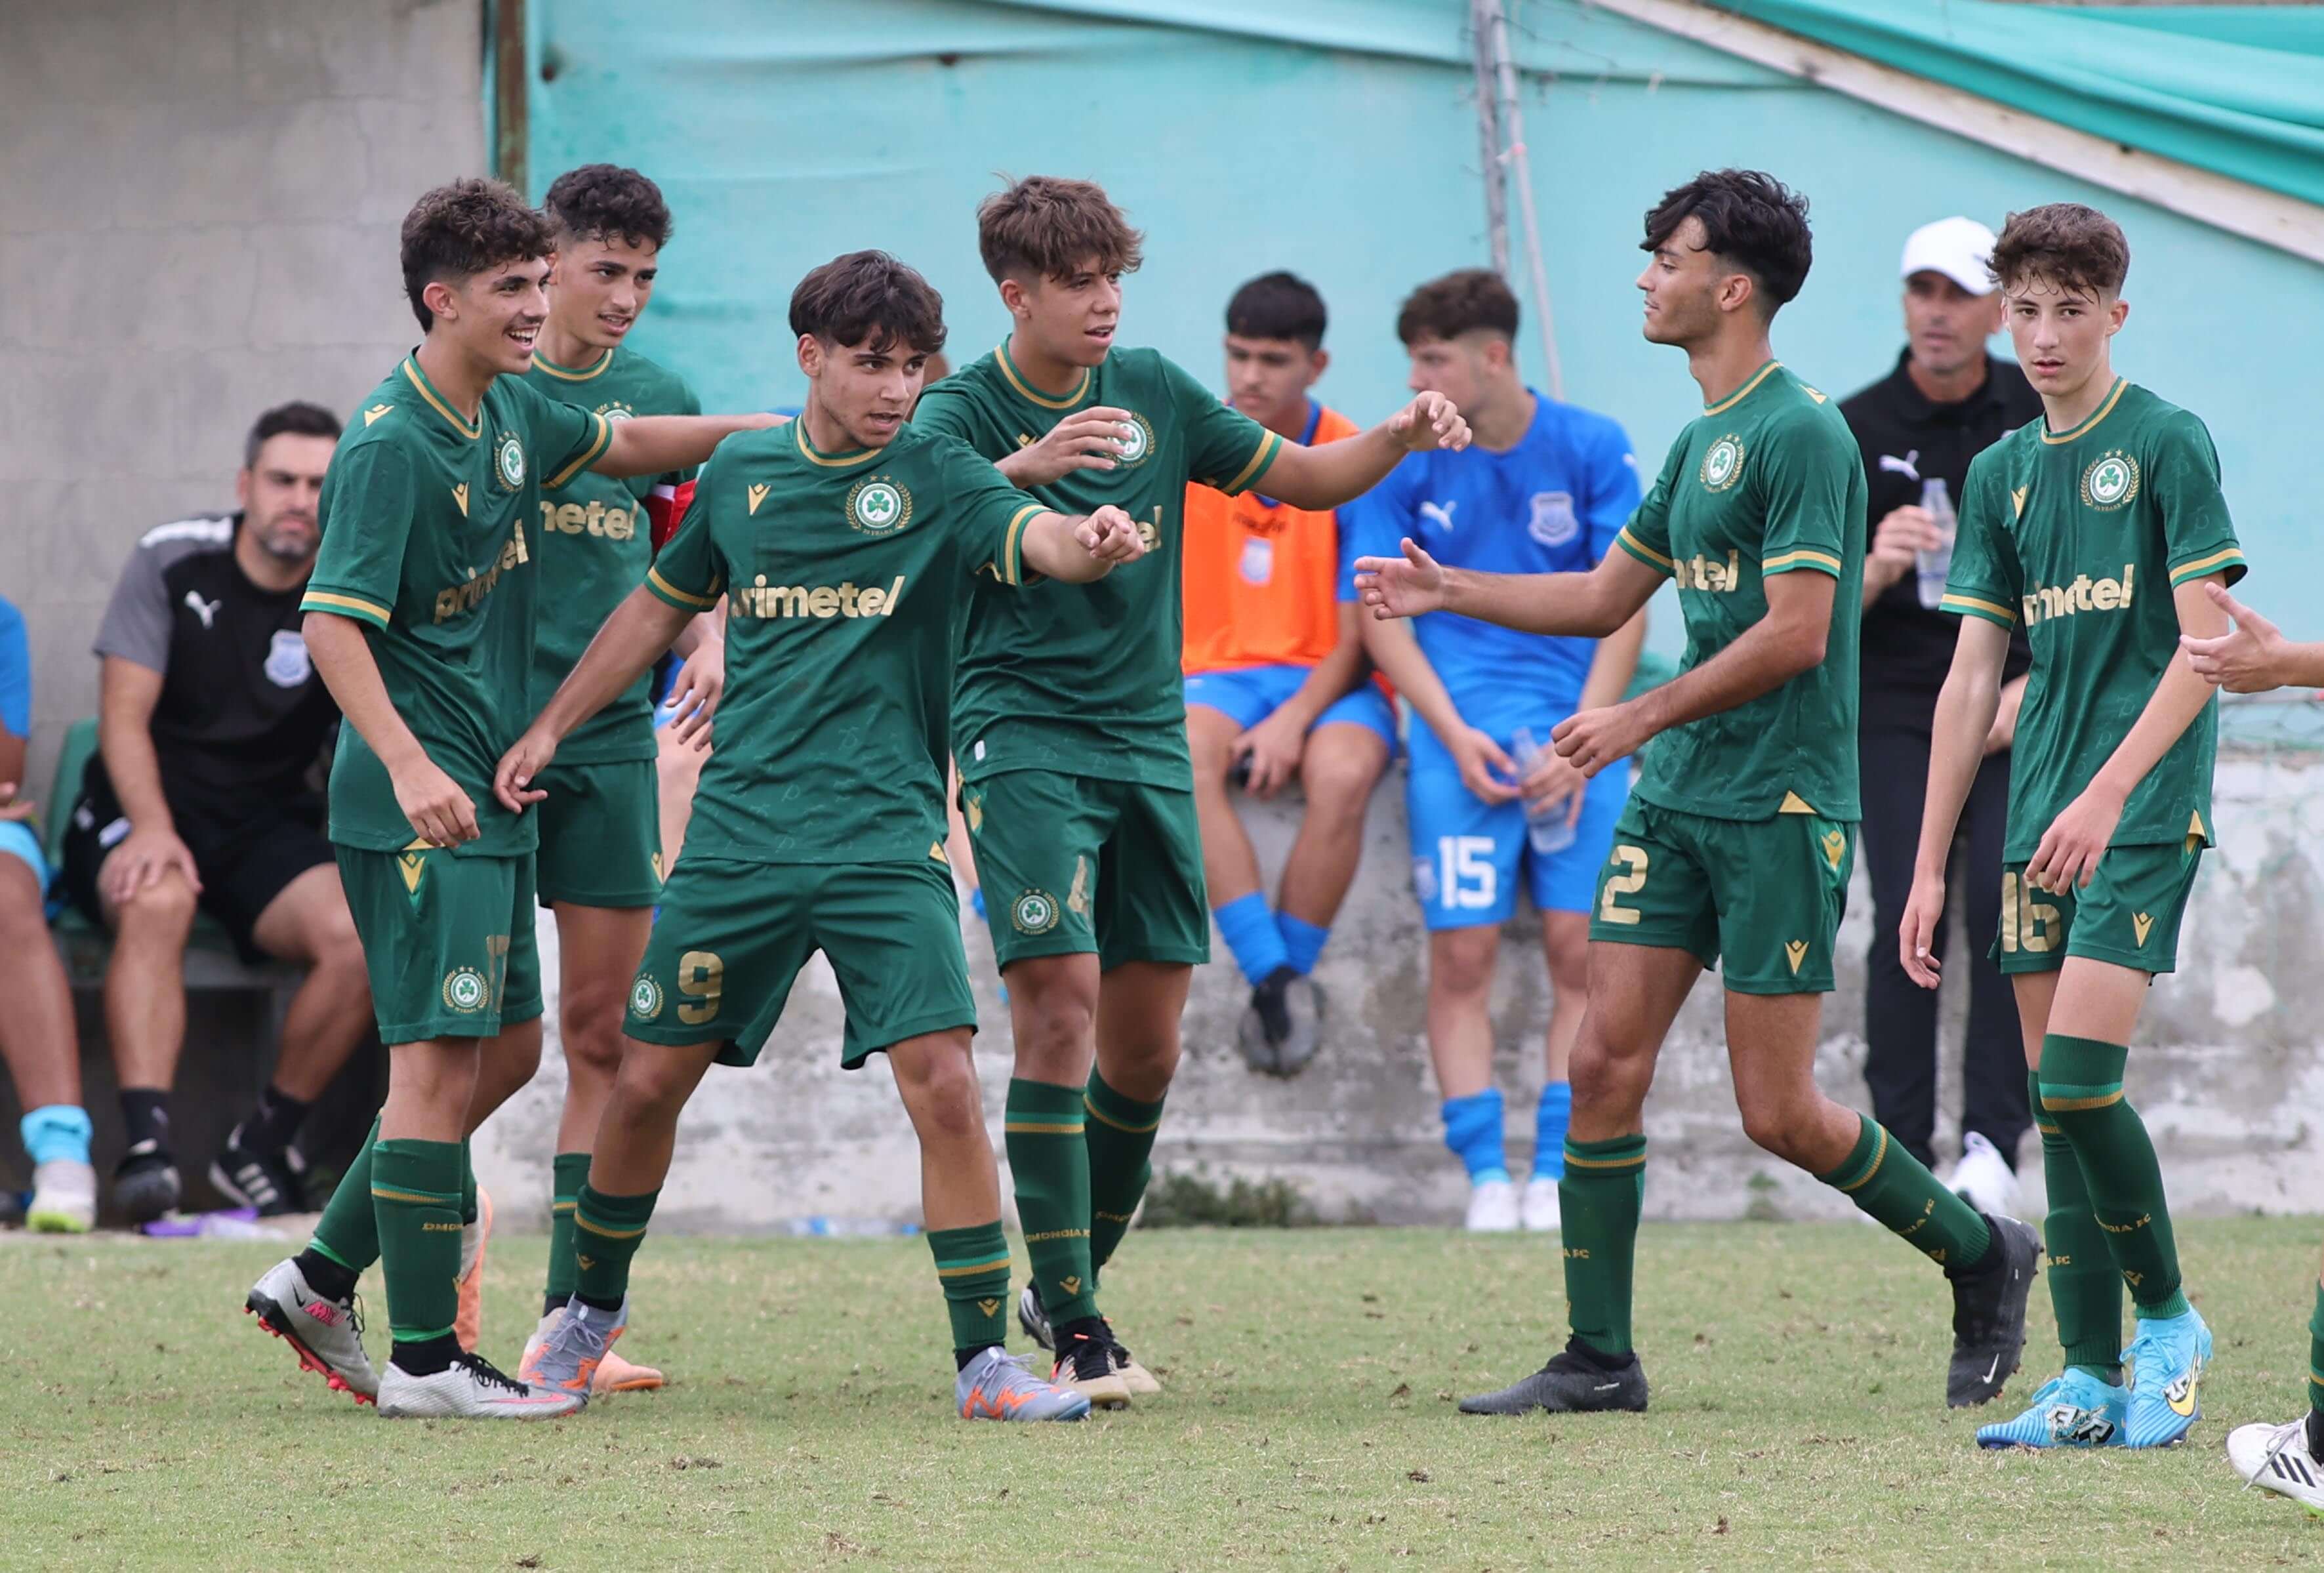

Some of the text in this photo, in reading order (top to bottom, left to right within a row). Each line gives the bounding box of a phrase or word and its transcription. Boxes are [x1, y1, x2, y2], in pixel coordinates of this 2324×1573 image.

[1438, 835, 1496, 909] 15
[1600, 844, 1648, 925] 2
[2003, 871, 2061, 952] 16
[678, 950, 724, 1025] 9
